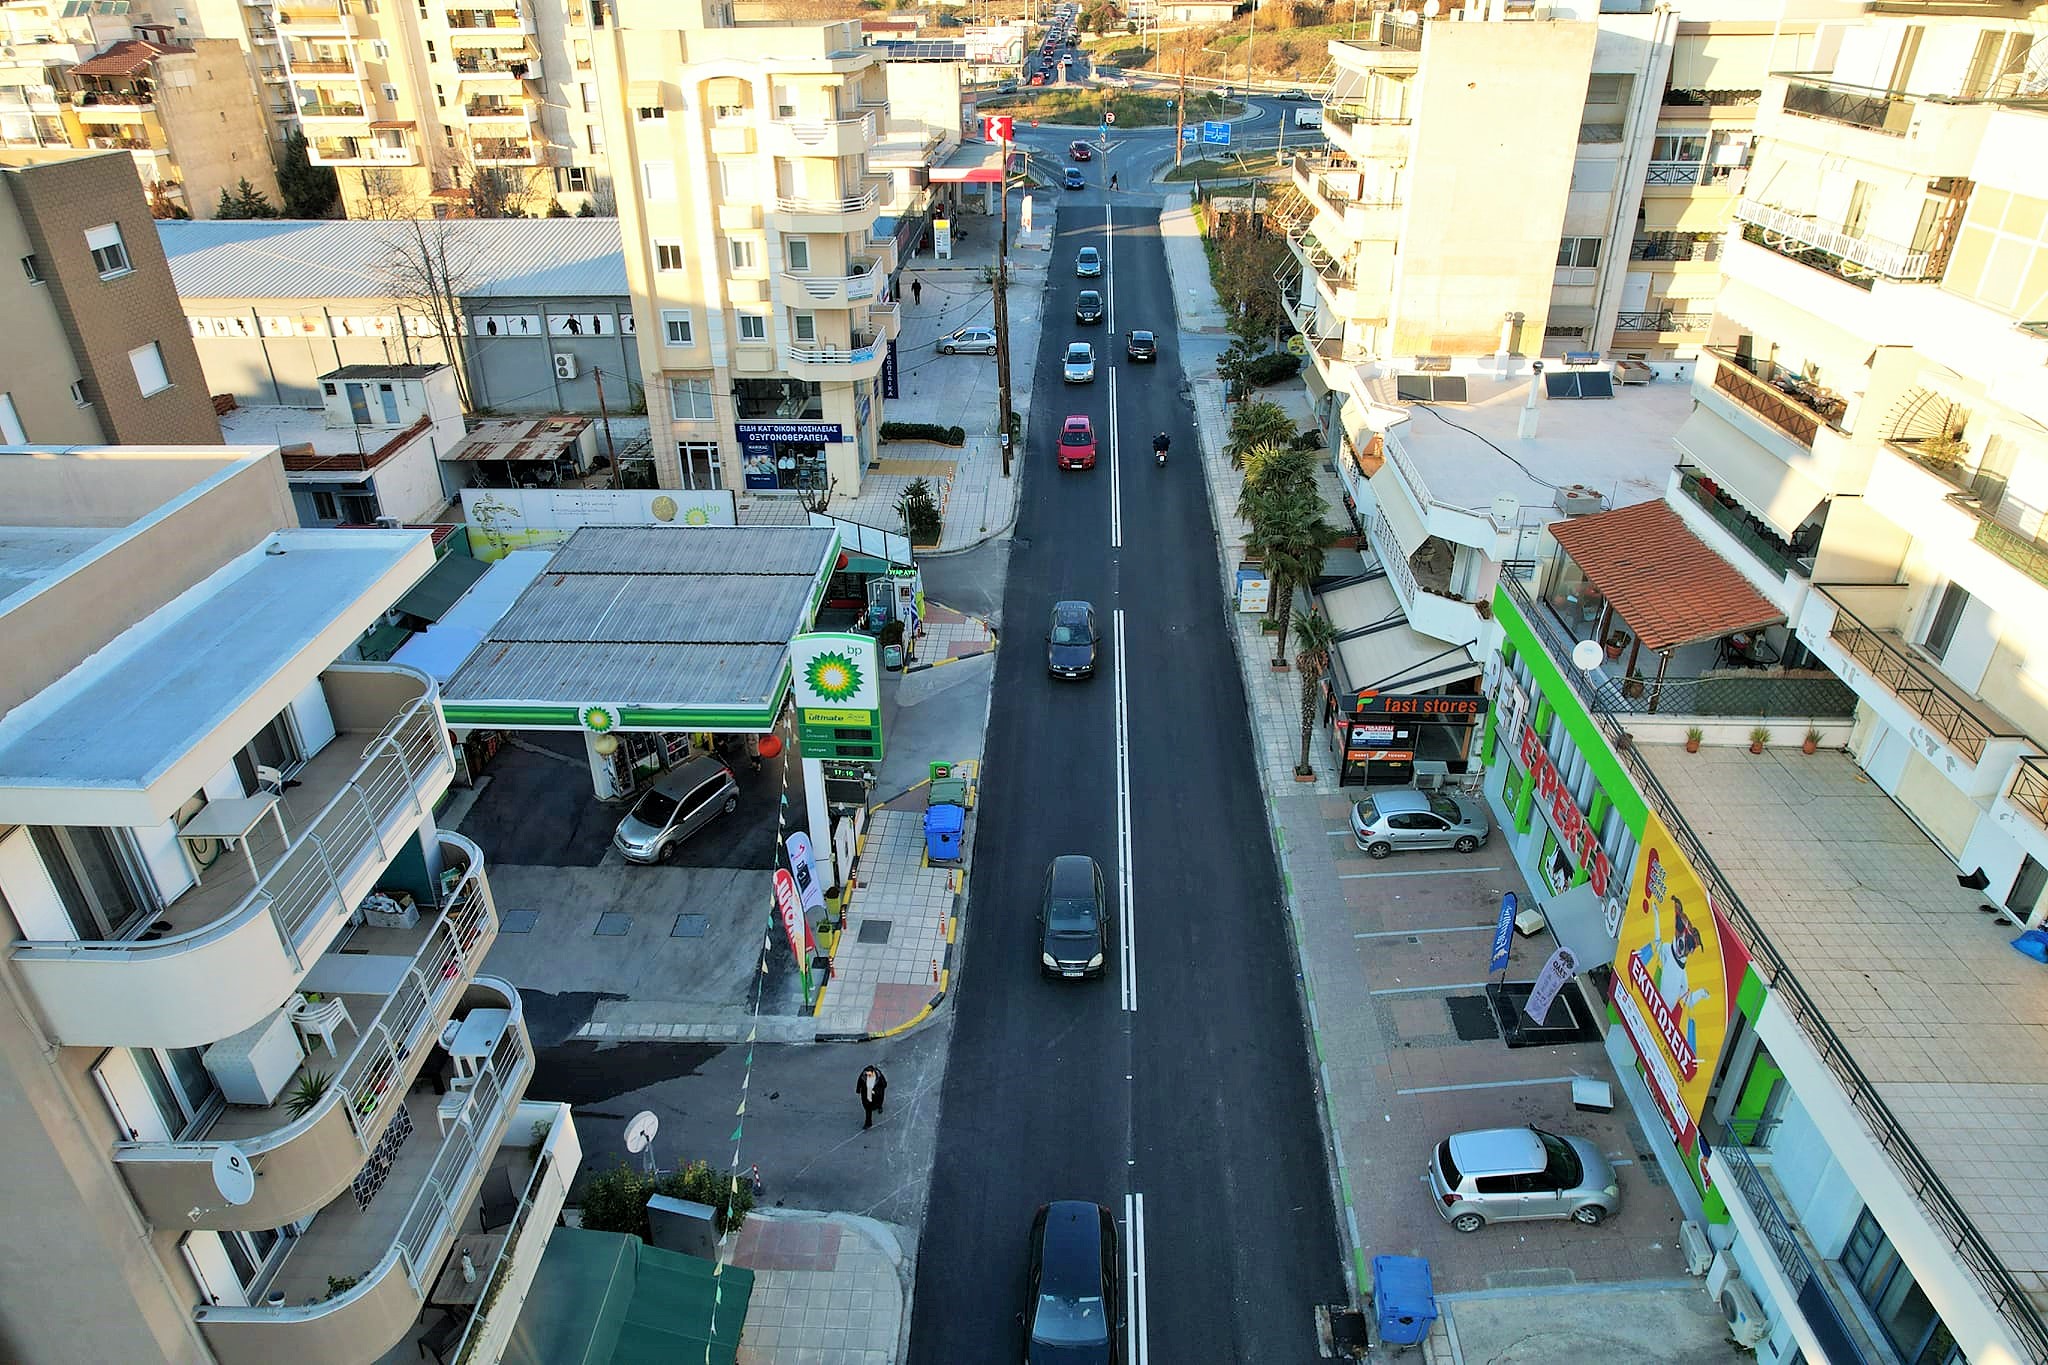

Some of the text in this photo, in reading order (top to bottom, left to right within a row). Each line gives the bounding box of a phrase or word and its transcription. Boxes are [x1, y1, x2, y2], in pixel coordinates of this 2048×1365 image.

[797, 425, 838, 433] ΝΟΣΗΛΕΙΑΣ
[749, 433, 830, 442] ΟΞΥΓΟΝΟΘΕΡΑΠΕΙΑ
[706, 502, 721, 516] bp
[847, 644, 863, 657] bp
[1384, 696, 1418, 713] fast
[1423, 698, 1478, 713] stores
[1632, 957, 1691, 1075] ΕΚΠΤΩΣΕΙΣ
